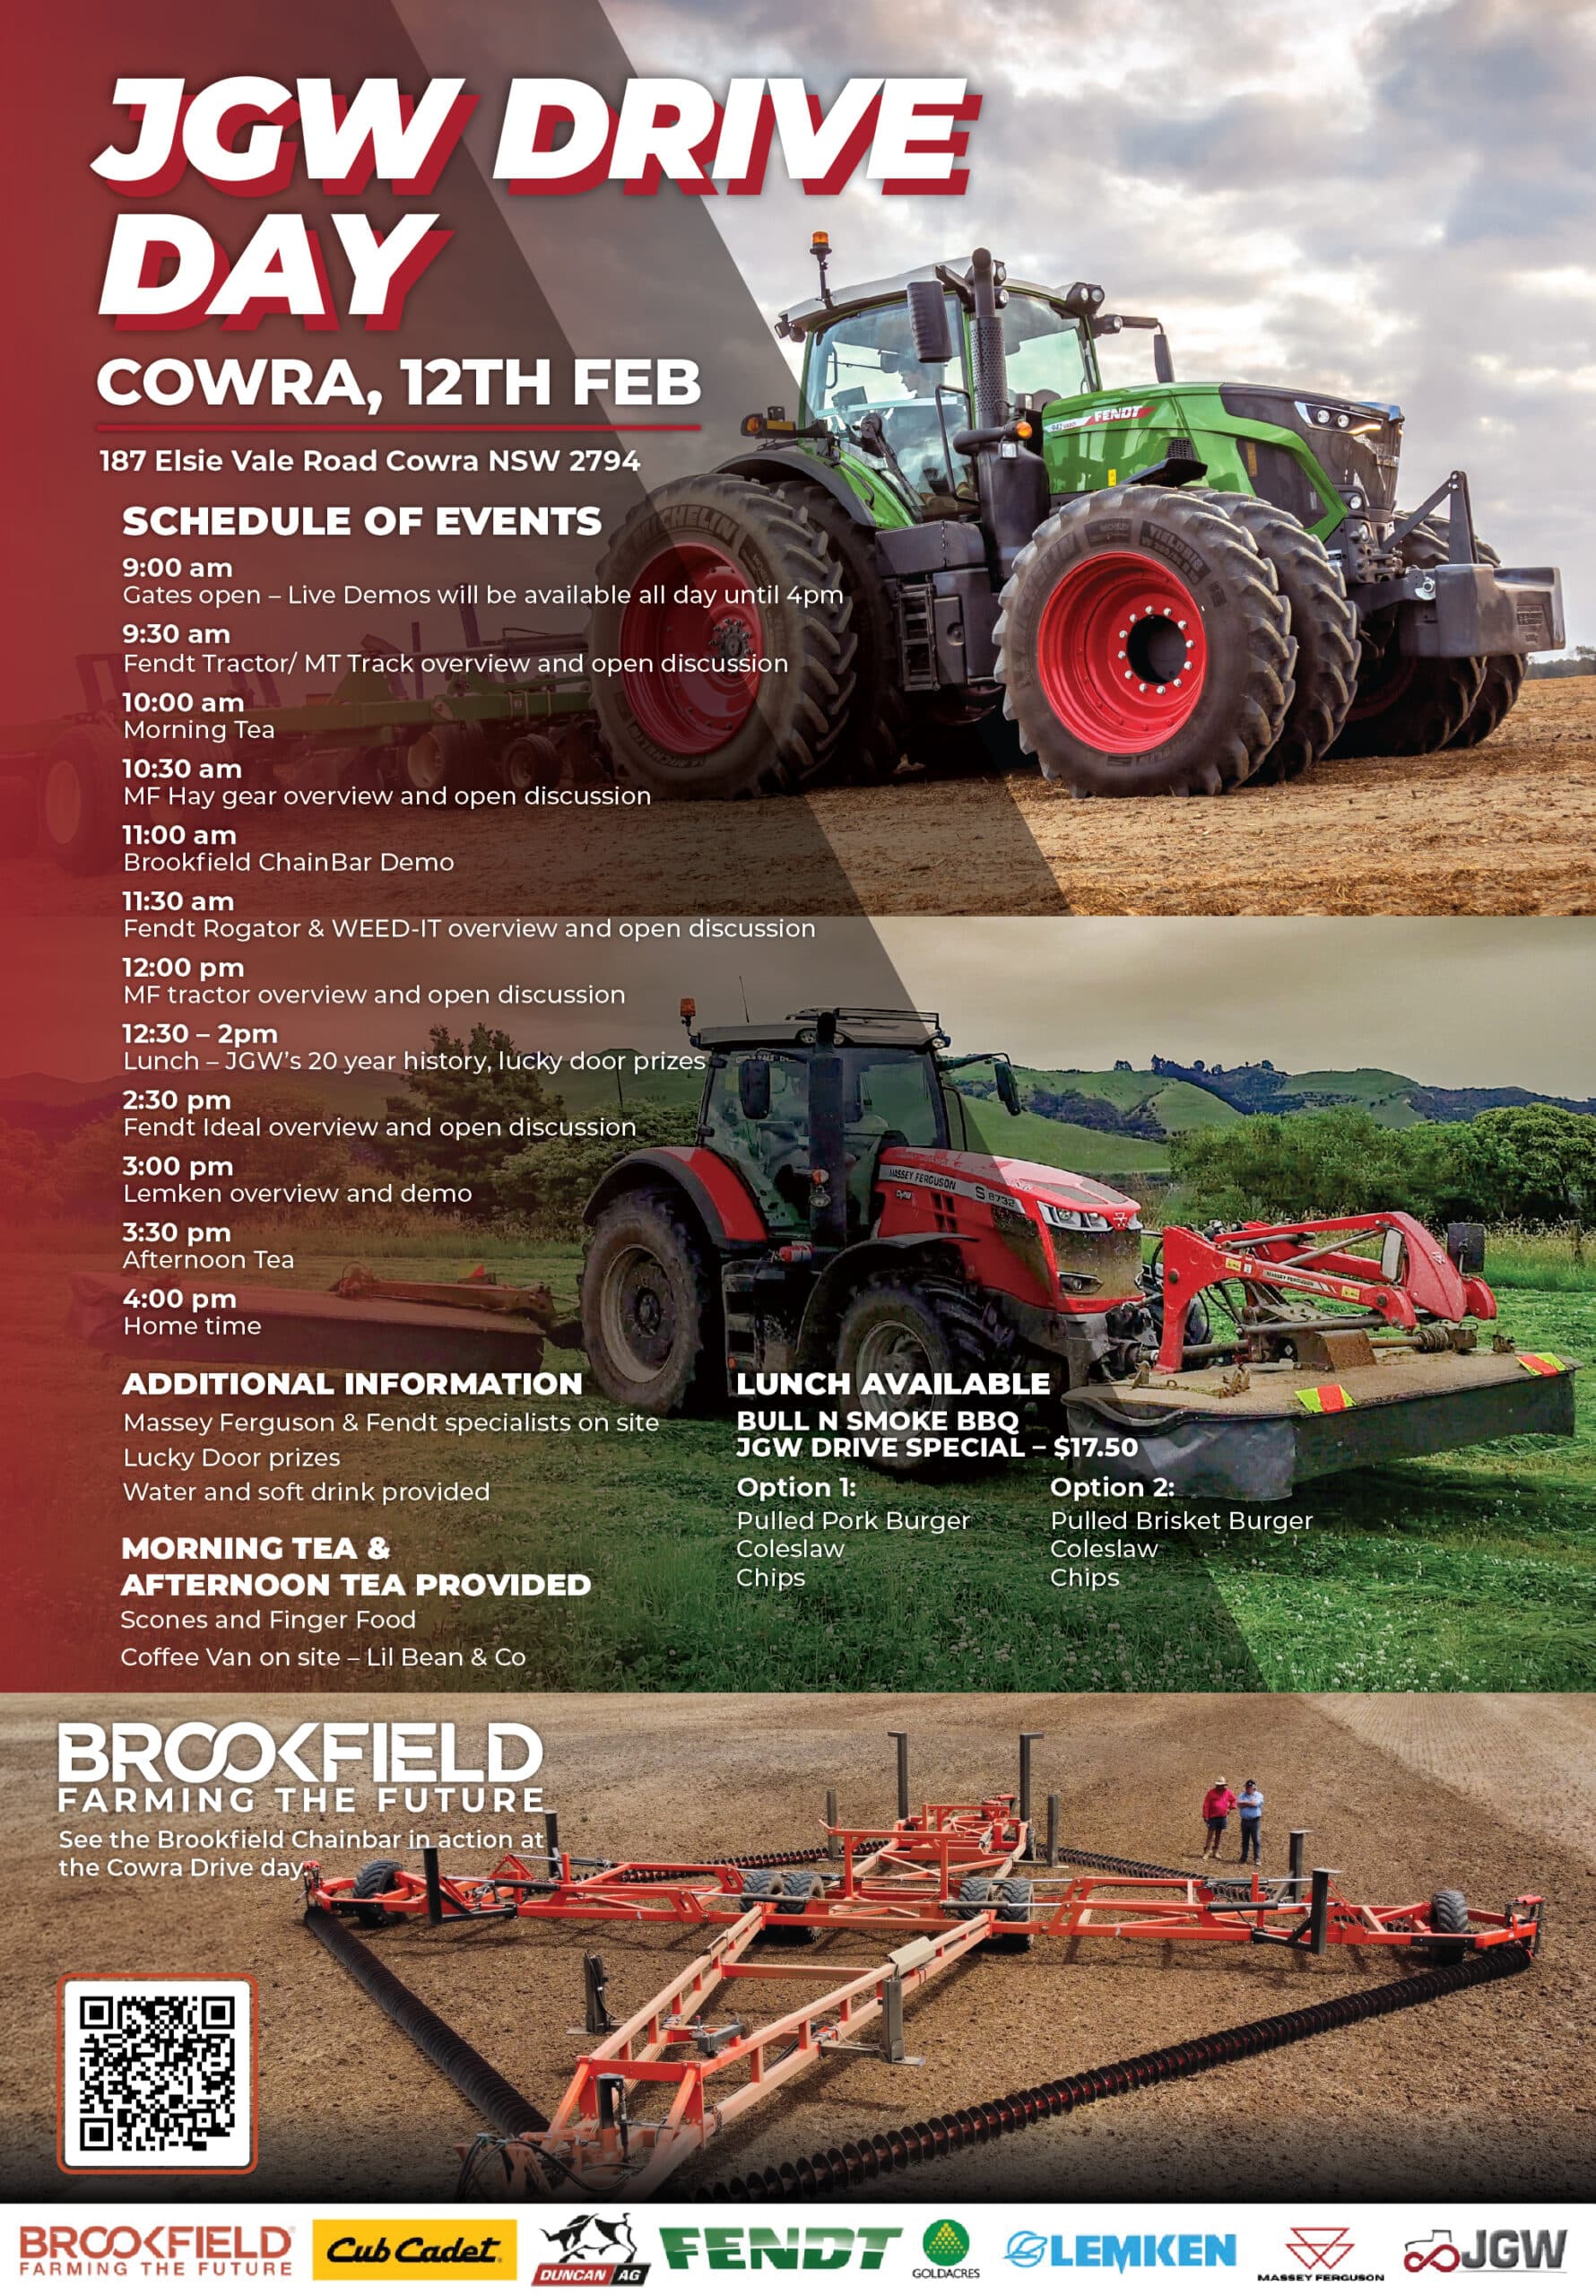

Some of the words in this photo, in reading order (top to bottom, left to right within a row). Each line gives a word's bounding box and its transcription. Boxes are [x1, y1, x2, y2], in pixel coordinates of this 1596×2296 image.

[91, 75, 466, 182] JGW
[493, 77, 968, 180] DRIVE
[99, 213, 440, 316] DAY
[97, 357, 383, 416] COWRA,
[400, 357, 551, 406] 12TH
[575, 358, 702, 406] FEB
[1094, 405, 1143, 422] FENDT
[99, 448, 147, 473] 187
[155, 448, 224, 473] Elsie
[230, 448, 295, 473] Vale
[303, 448, 377, 473] Road
[386, 449, 479, 473] Cowra
[489, 448, 561, 473] NSW
[568, 448, 642, 473] 2794
[122, 505, 351, 537] SCHEDULE
[363, 505, 424, 537] OF
[436, 505, 603, 537] EVENTS
[122, 556, 183, 578] 9:00
[188, 561, 233, 578] am
[121, 622, 180, 645] 9:30
[187, 628, 231, 645] am
[124, 652, 196, 674] Fendt
[201, 650, 299, 675] Tractor/
[305, 653, 343, 674] MT
[346, 652, 414, 674] Track
[421, 653, 532, 674] overview
[537, 652, 584, 674] and
[591, 657, 654, 678] open
[660, 652, 789, 674] discussion
[121, 691, 195, 713] 10:00
[201, 696, 245, 713] am
[124, 719, 227, 744] Morning
[233, 719, 275, 740] Tea
[121, 758, 192, 779] 10:30
[198, 762, 242, 779] am
[121, 823, 186, 846] 11:00
[193, 829, 237, 846] am
[124, 851, 251, 872] Brookfield
[258, 851, 373, 872] ChainBar
[380, 852, 455, 872] Demo
[121, 890, 184, 912] 11:30
[190, 895, 235, 912] am
[121, 956, 192, 978] 12:00
[199, 961, 245, 983] pm
[122, 1089, 178, 1110] 2:30
[186, 1093, 231, 1115] pm
[122, 1155, 181, 1177] 3:00
[189, 1160, 234, 1181] pm
[124, 1182, 222, 1204] Lemken
[230, 1182, 340, 1204] overview
[346, 1182, 393, 1204] and
[400, 1182, 473, 1204] demo
[915, 1172, 957, 1190] FERGUSON
[988, 1192, 1016, 1207] 8732
[122, 1222, 178, 1243] 3:30
[186, 1226, 231, 1248] pm
[122, 1248, 247, 1269] Afternoon
[253, 1249, 295, 1270] Tea
[122, 1288, 184, 1309] 4:00
[192, 1292, 237, 1314] pm
[124, 1316, 199, 1336] Home
[204, 1317, 262, 1336] time
[121, 1371, 335, 1396] ADDITIONAL
[344, 1371, 583, 1396] INFORMATION
[736, 1371, 851, 1396] LUNCH
[859, 1371, 1051, 1396] AVAILABLE
[124, 1413, 213, 1437] Massey
[220, 1412, 335, 1437] Ferguson
[342, 1413, 360, 1432] &
[366, 1412, 438, 1432] Fendt
[445, 1412, 572, 1437] specialists
[577, 1416, 610, 1432] on
[616, 1412, 660, 1432] site
[737, 1410, 811, 1431] BULL
[819, 1410, 838, 1431] N
[846, 1410, 949, 1431] SMOKE
[957, 1410, 1020, 1436] BBQ
[124, 1447, 195, 1472] Lucky
[202, 1448, 262, 1467] Door
[269, 1447, 341, 1473] prizes
[735, 1437, 803, 1458] JGW
[811, 1436, 898, 1458] DRIVE
[905, 1437, 1027, 1458] SPECIAL
[1053, 1434, 1140, 1461] $17.50
[122, 1482, 197, 1502] Water
[204, 1481, 251, 1502] and
[257, 1481, 305, 1501] soft
[310, 1481, 376, 1502] drink
[382, 1481, 490, 1507] provided
[736, 1474, 831, 1502] Option
[838, 1476, 856, 1498] 1:
[1050, 1475, 1145, 1502] Option
[1152, 1476, 1175, 1498] 2:
[737, 1509, 814, 1531] Pulled
[822, 1509, 880, 1531] Pork
[886, 1510, 971, 1535] Burger
[1051, 1509, 1128, 1531] Pulled
[1136, 1509, 1222, 1531] Brisket
[1229, 1510, 1314, 1535] Burger
[122, 1535, 283, 1561] MORNING
[291, 1536, 359, 1561] TEA
[367, 1535, 391, 1561] &
[736, 1538, 846, 1559] Coleslaw
[1050, 1538, 1159, 1559] Coleslaw
[119, 1572, 330, 1597] AFTERNOON
[339, 1573, 407, 1596] TEA
[415, 1572, 593, 1597] PROVIDED
[736, 1567, 806, 1592] Chips
[1050, 1567, 1121, 1592] Chips
[120, 1609, 209, 1630] Scones
[214, 1609, 261, 1630] and
[270, 1609, 348, 1634] Finger
[356, 1609, 416, 1630] Food
[58, 1721, 543, 1784] BROOKFIELD
[57, 1787, 254, 1813] FARMING
[273, 1787, 356, 1813] THE
[377, 1787, 544, 1813] FUTURE
[58, 1830, 104, 1849] See
[108, 1829, 151, 1849] the
[157, 1829, 284, 1849] Brookfield
[291, 1828, 403, 1849] Chainbar
[409, 1829, 431, 1849] in
[438, 1829, 513, 1849] action
[520, 1831, 544, 1849] at
[57, 1857, 100, 1877] the
[106, 1857, 183, 1877] Cowra
[190, 1857, 254, 1877] Drive
[260, 1857, 309, 1883] day.
[20, 2225, 292, 2260] BROOKFIELD
[326, 2237, 391, 2263] Cub
[395, 2237, 501, 2263] Cadet
[658, 2226, 905, 2271] FENDT
[1050, 2233, 1237, 2274] LEMKEN
[1461, 2229, 1568, 2270] JGW
[20, 2261, 127, 2276] FARMING
[140, 2261, 185, 2276] THE
[198, 2261, 292, 2276] FUTURE
[540, 2269, 606, 2281] DUNCAN
[618, 2269, 641, 2281] AG
[912, 2268, 981, 2279] GOLDACRES
[1257, 2274, 1314, 2282] MASSEY
[1314, 2274, 1385, 2282] FERGUSON
